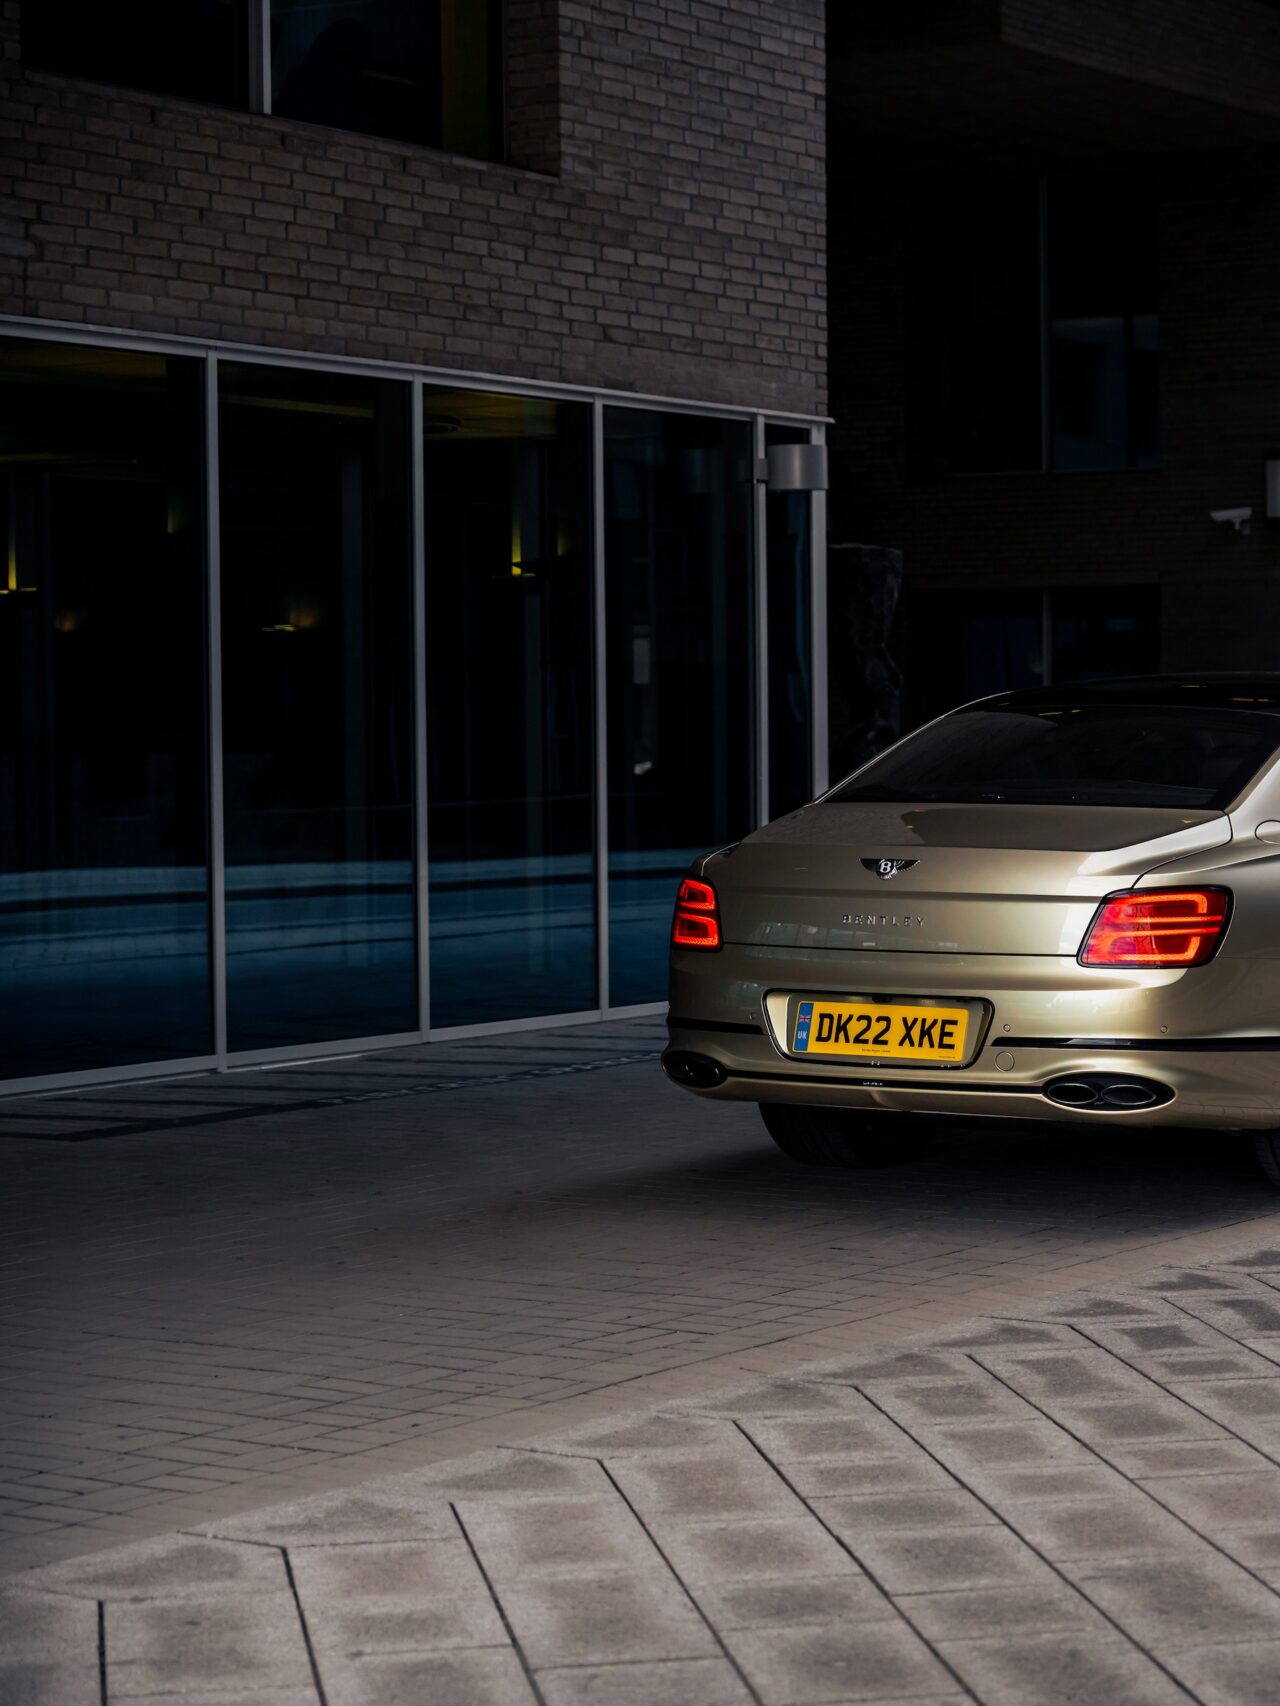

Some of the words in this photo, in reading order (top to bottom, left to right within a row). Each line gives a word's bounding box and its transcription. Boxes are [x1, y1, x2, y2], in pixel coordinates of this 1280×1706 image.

[842, 914, 926, 927] BENTLEY
[797, 1031, 807, 1040] UK
[815, 1012, 891, 1046] DK22
[898, 1016, 959, 1050] XKE
